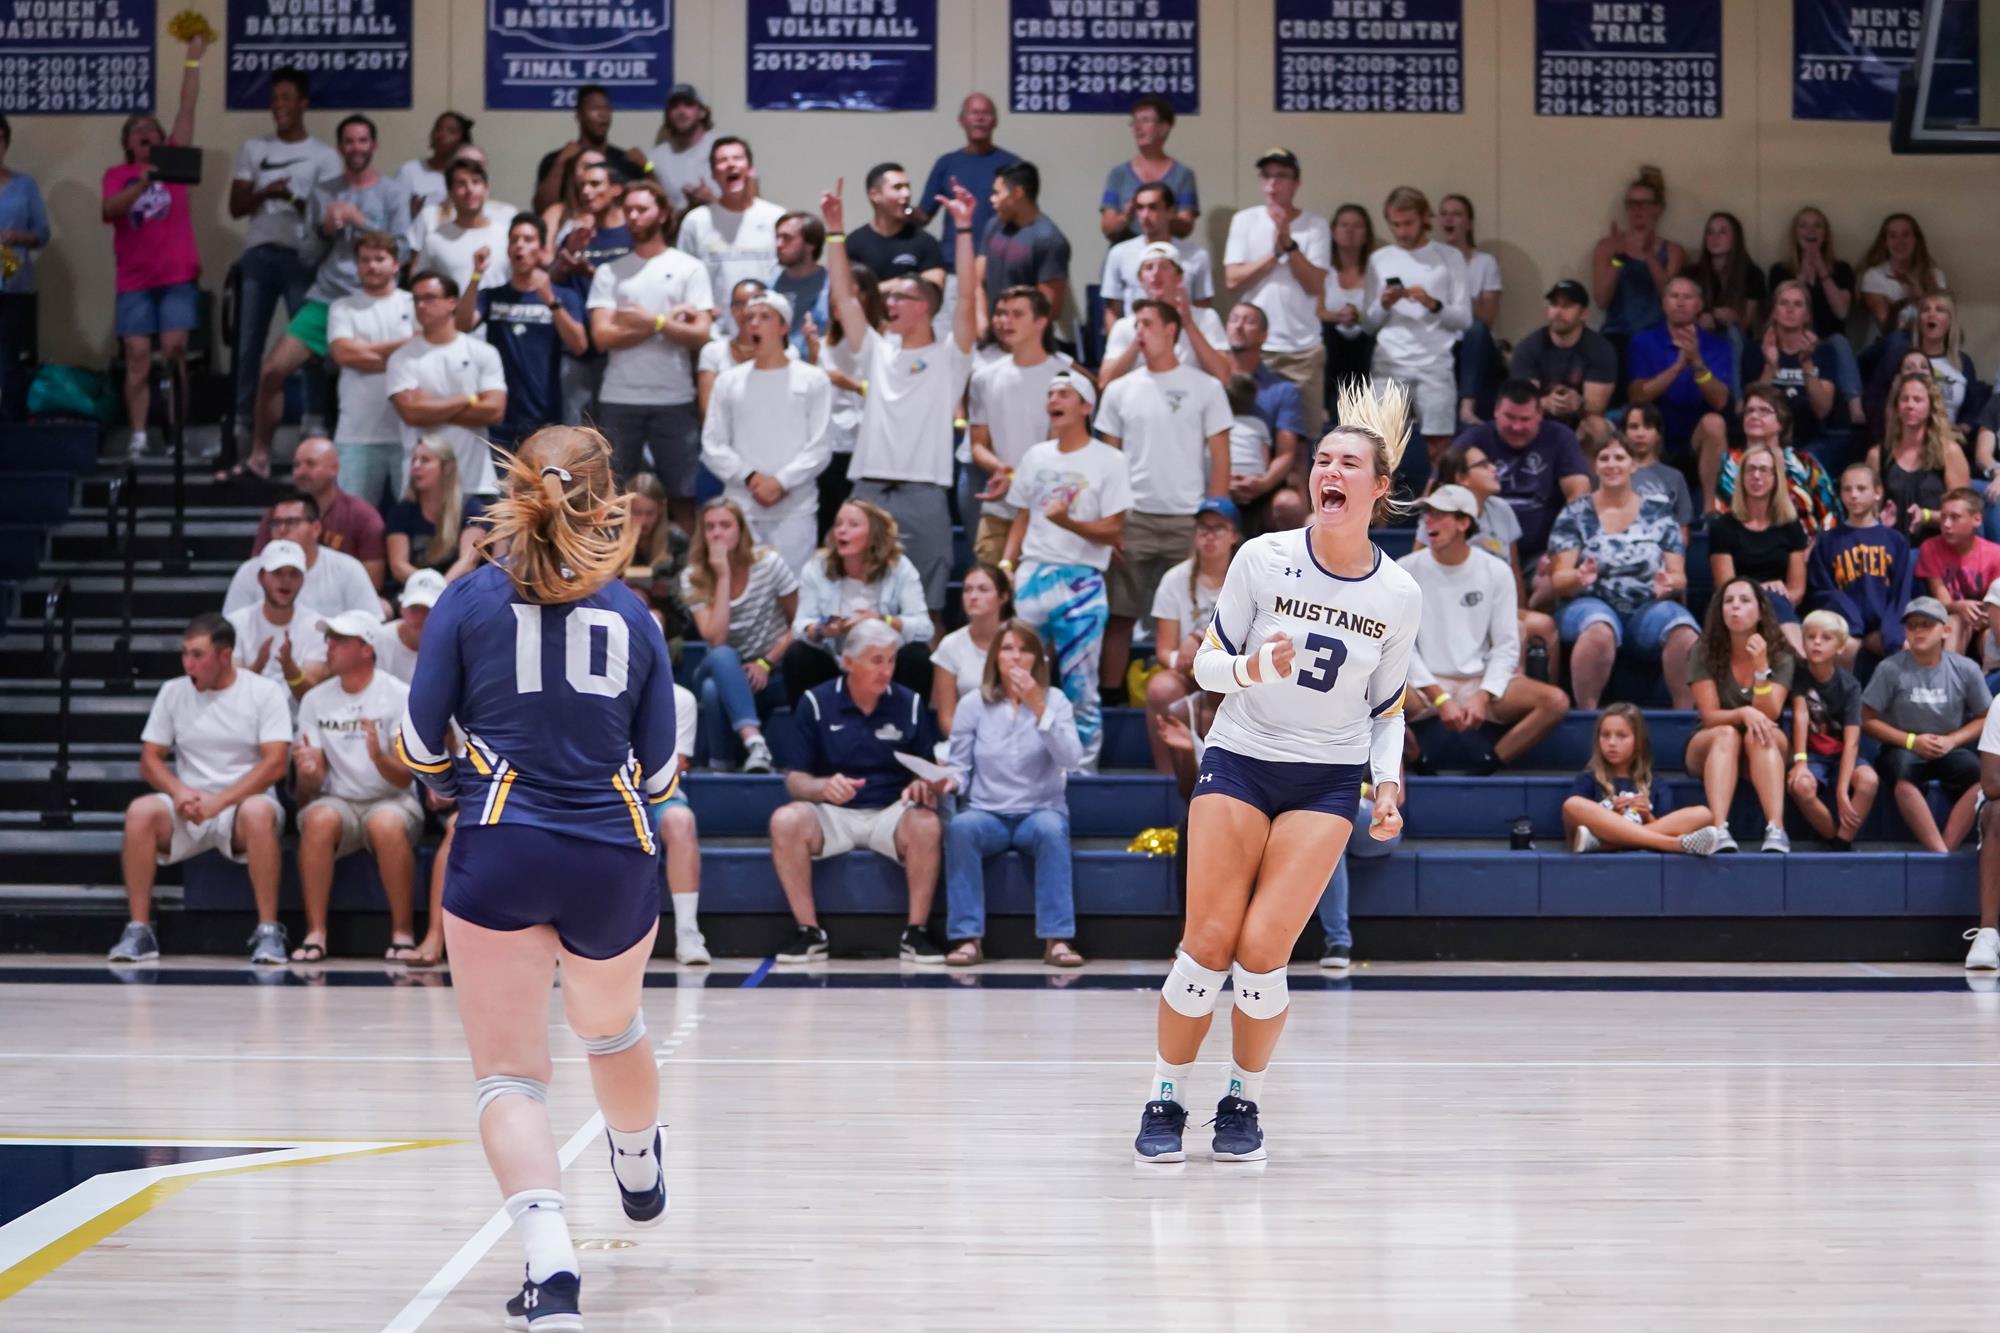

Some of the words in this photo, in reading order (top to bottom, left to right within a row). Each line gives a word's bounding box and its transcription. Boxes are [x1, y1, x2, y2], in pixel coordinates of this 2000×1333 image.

[268, 0, 376, 15] WOMENS
[789, 0, 897, 15] WOMENS
[1332, 0, 1407, 18] MEN'S
[1592, 2, 1666, 23] MEN'S
[245, 15, 397, 36] BASKETBALL
[504, 8, 656, 28] BASKETBALL
[766, 17, 919, 37] VOLLEYBALL
[1850, 8, 1920, 28] MEN'S
[1013, 18, 1086, 39] CROSS
[1091, 20, 1195, 40] COUNTRY
[1279, 19, 1350, 39] CROSS
[1356, 20, 1458, 40] COUNTRY
[1590, 24, 1667, 43] TRACK
[508, 60, 577, 78] FINAL
[584, 60, 649, 78] FOUR
[1800, 62, 1853, 81] 2017
[1015, 93, 1070, 111] 2016
[1274, 596, 1387, 640] MUSTANGS
[510, 603, 630, 699] 10
[1297, 632, 1349, 693] 3
